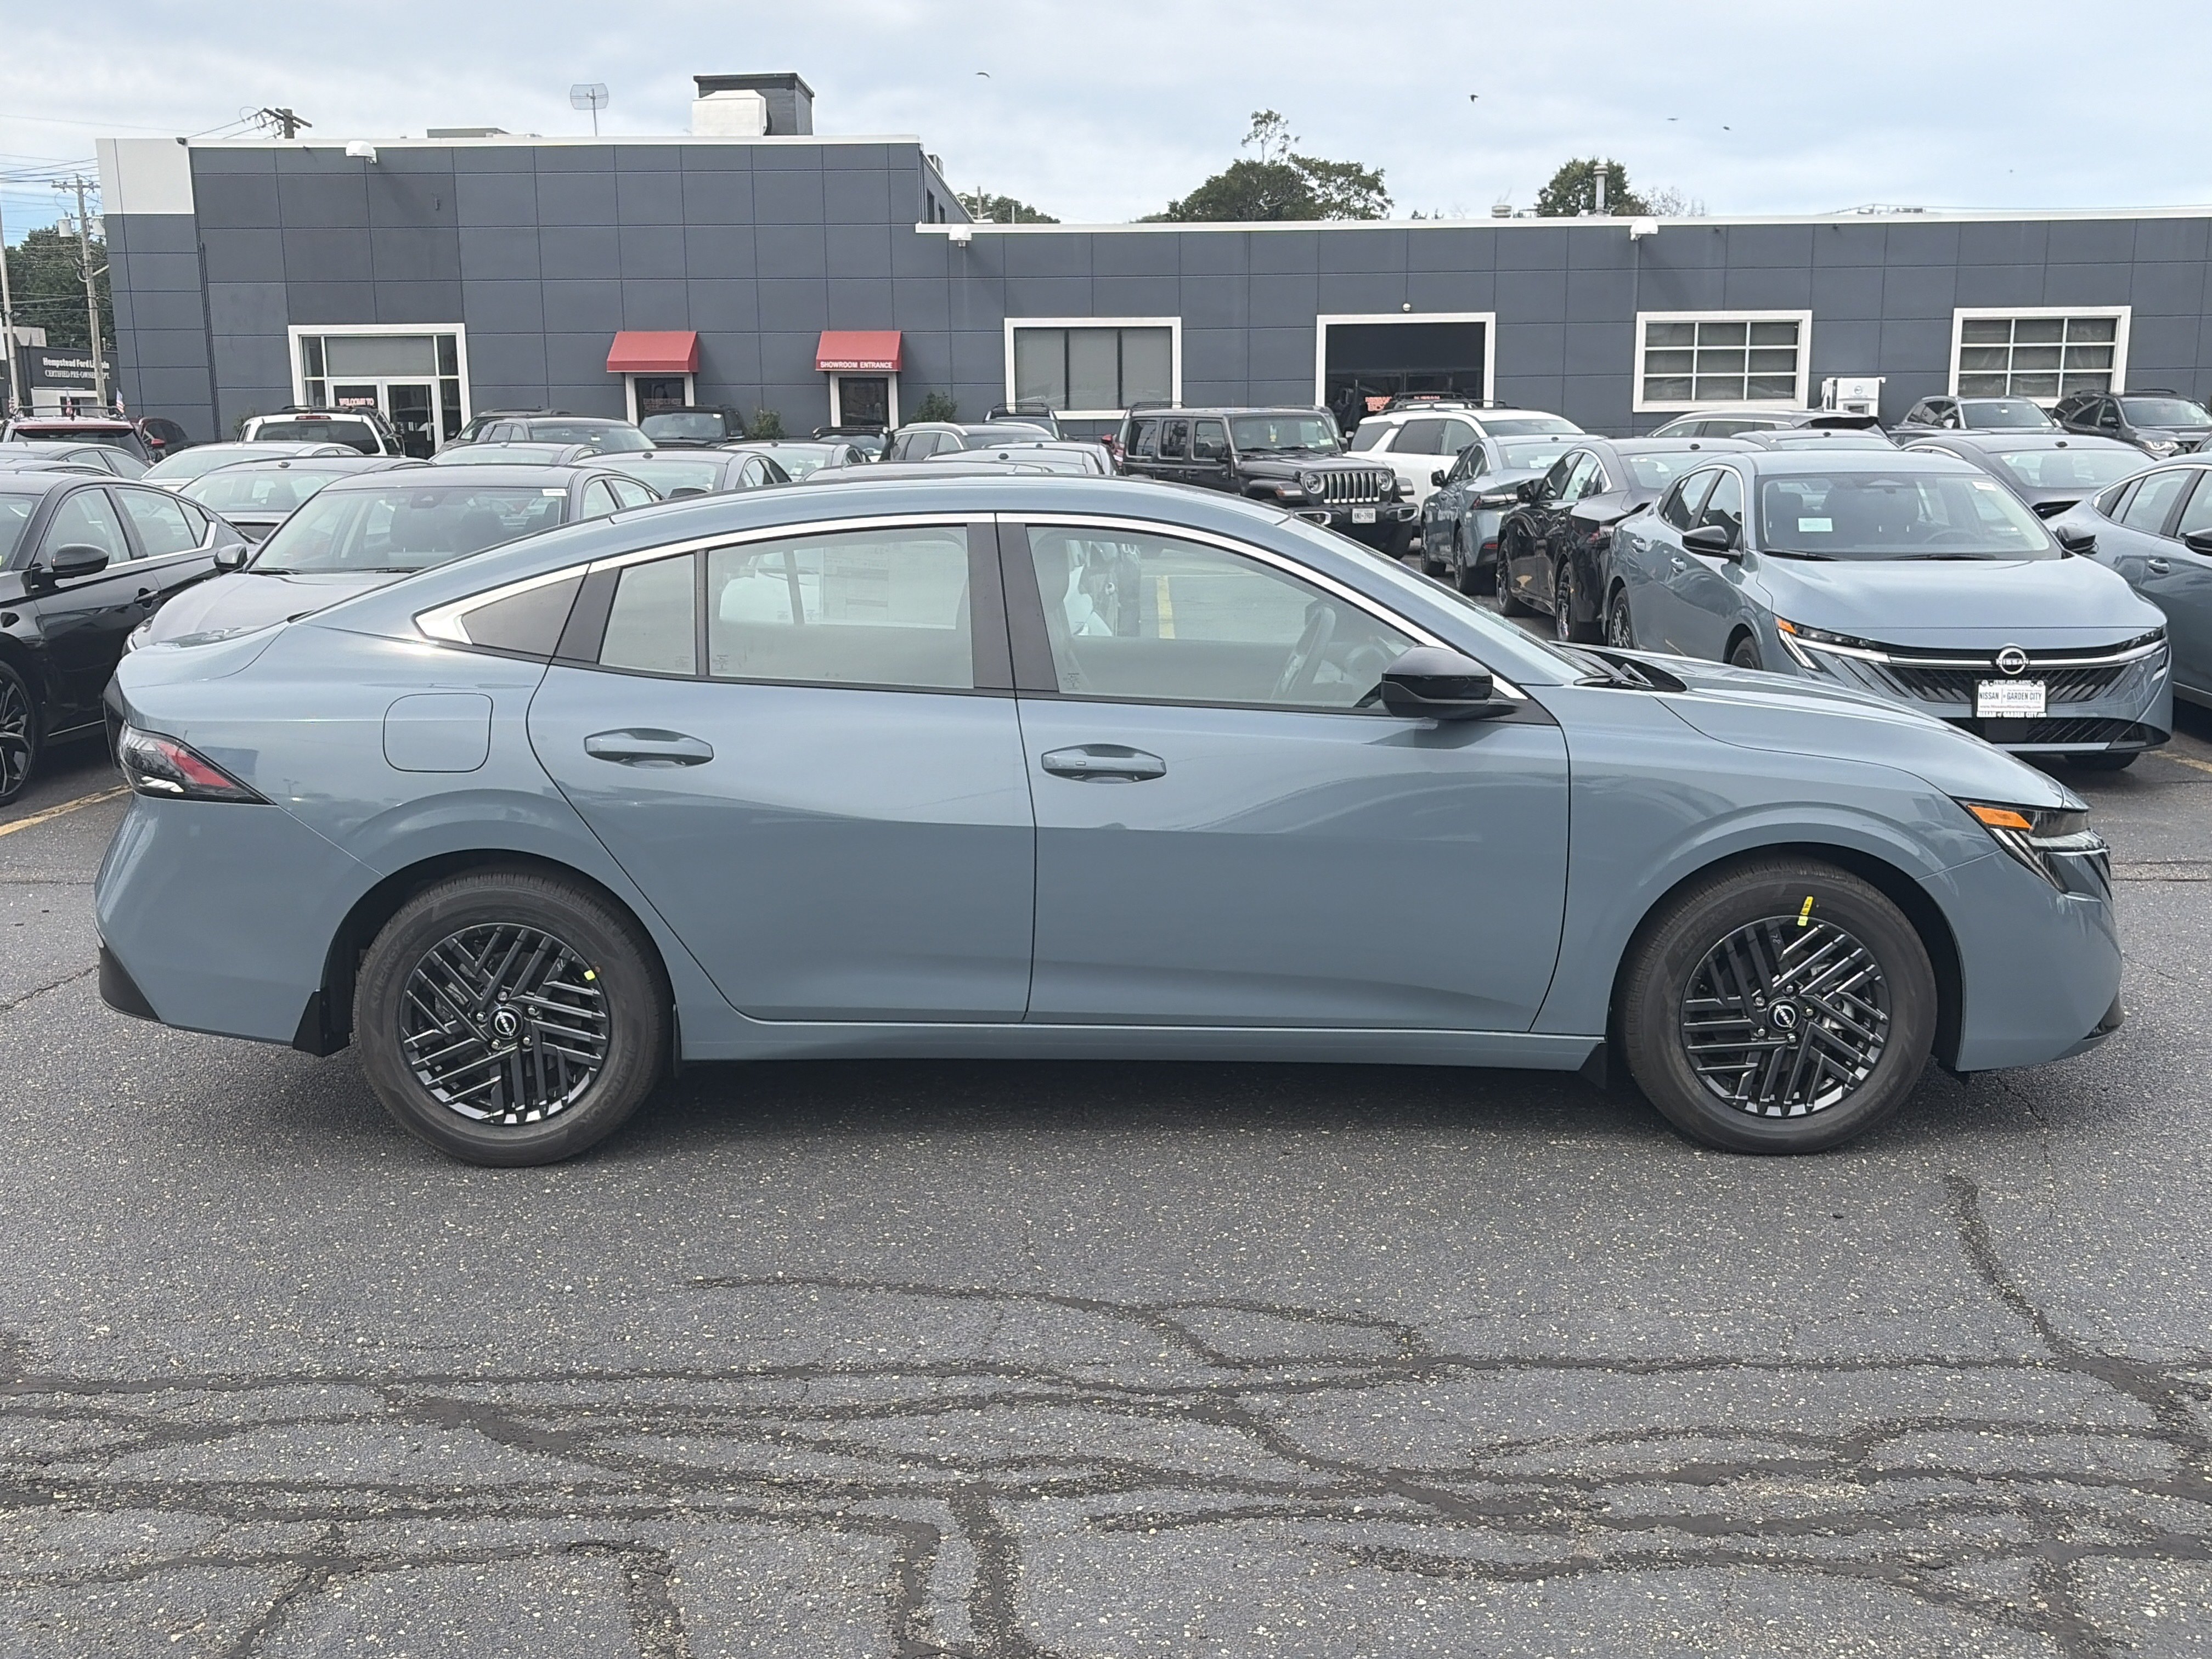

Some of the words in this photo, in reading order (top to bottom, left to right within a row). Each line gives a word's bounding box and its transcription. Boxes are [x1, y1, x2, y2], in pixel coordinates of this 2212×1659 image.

[43, 357, 76, 368] Hempstead
[76, 359, 89, 368] Ford
[45, 369, 70, 378] CERTIFIED
[338, 398, 366, 406] WELCOME
[366, 398, 374, 406] TO
[1776, 1005, 1793, 1028] NISSAN
[498, 1011, 514, 1036] NISSAN
